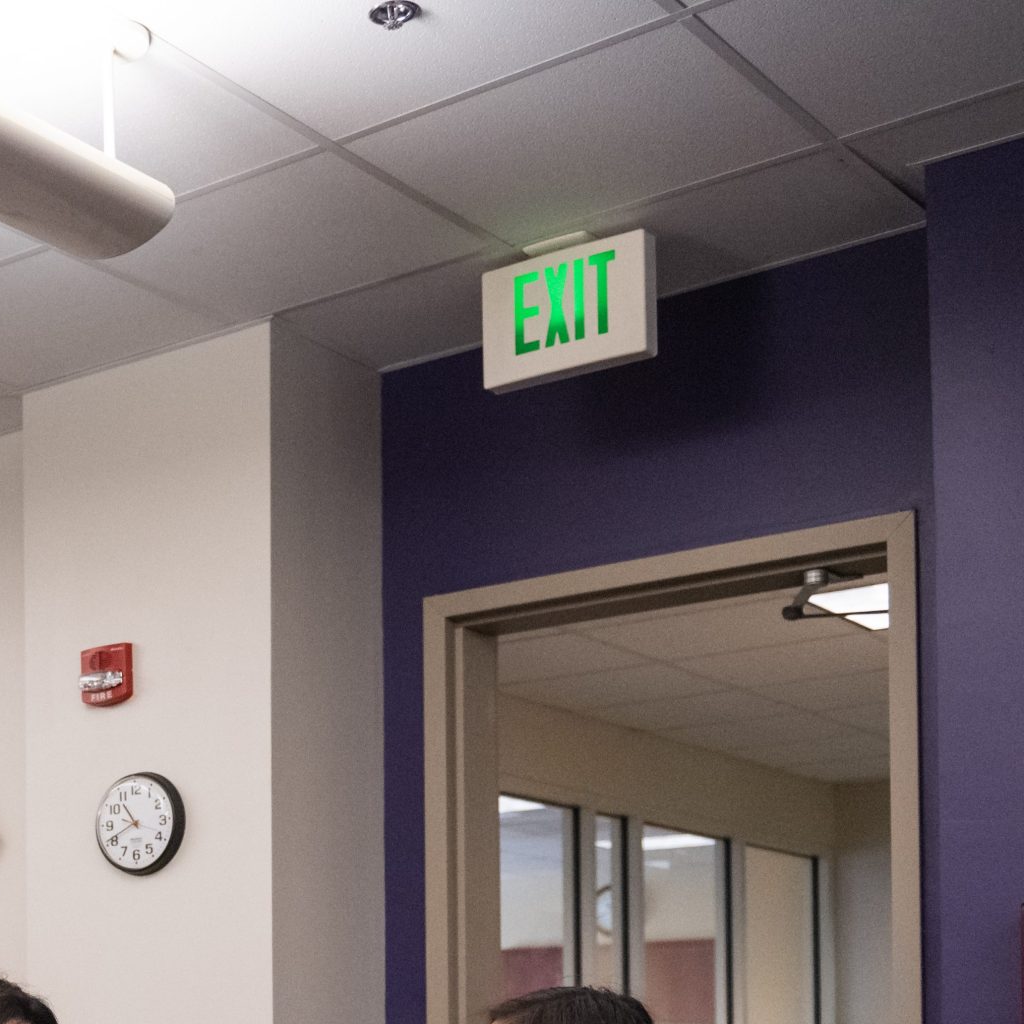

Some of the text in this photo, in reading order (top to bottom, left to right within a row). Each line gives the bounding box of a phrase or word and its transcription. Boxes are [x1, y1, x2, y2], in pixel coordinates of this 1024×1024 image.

[513, 249, 616, 356] EXIT
[90, 690, 113, 702] FIRE
[131, 785, 141, 795] 12
[119, 791, 127, 801] 11
[109, 803, 120, 815] 10
[154, 799, 161, 810] 2
[106, 820, 114, 831] 9
[159, 815, 167, 826] 3
[110, 835, 119, 846] 8
[154, 831, 163, 841] 4
[121, 846, 128, 857] 7
[145, 843, 153, 854] 5
[132, 849, 141, 861] 6
